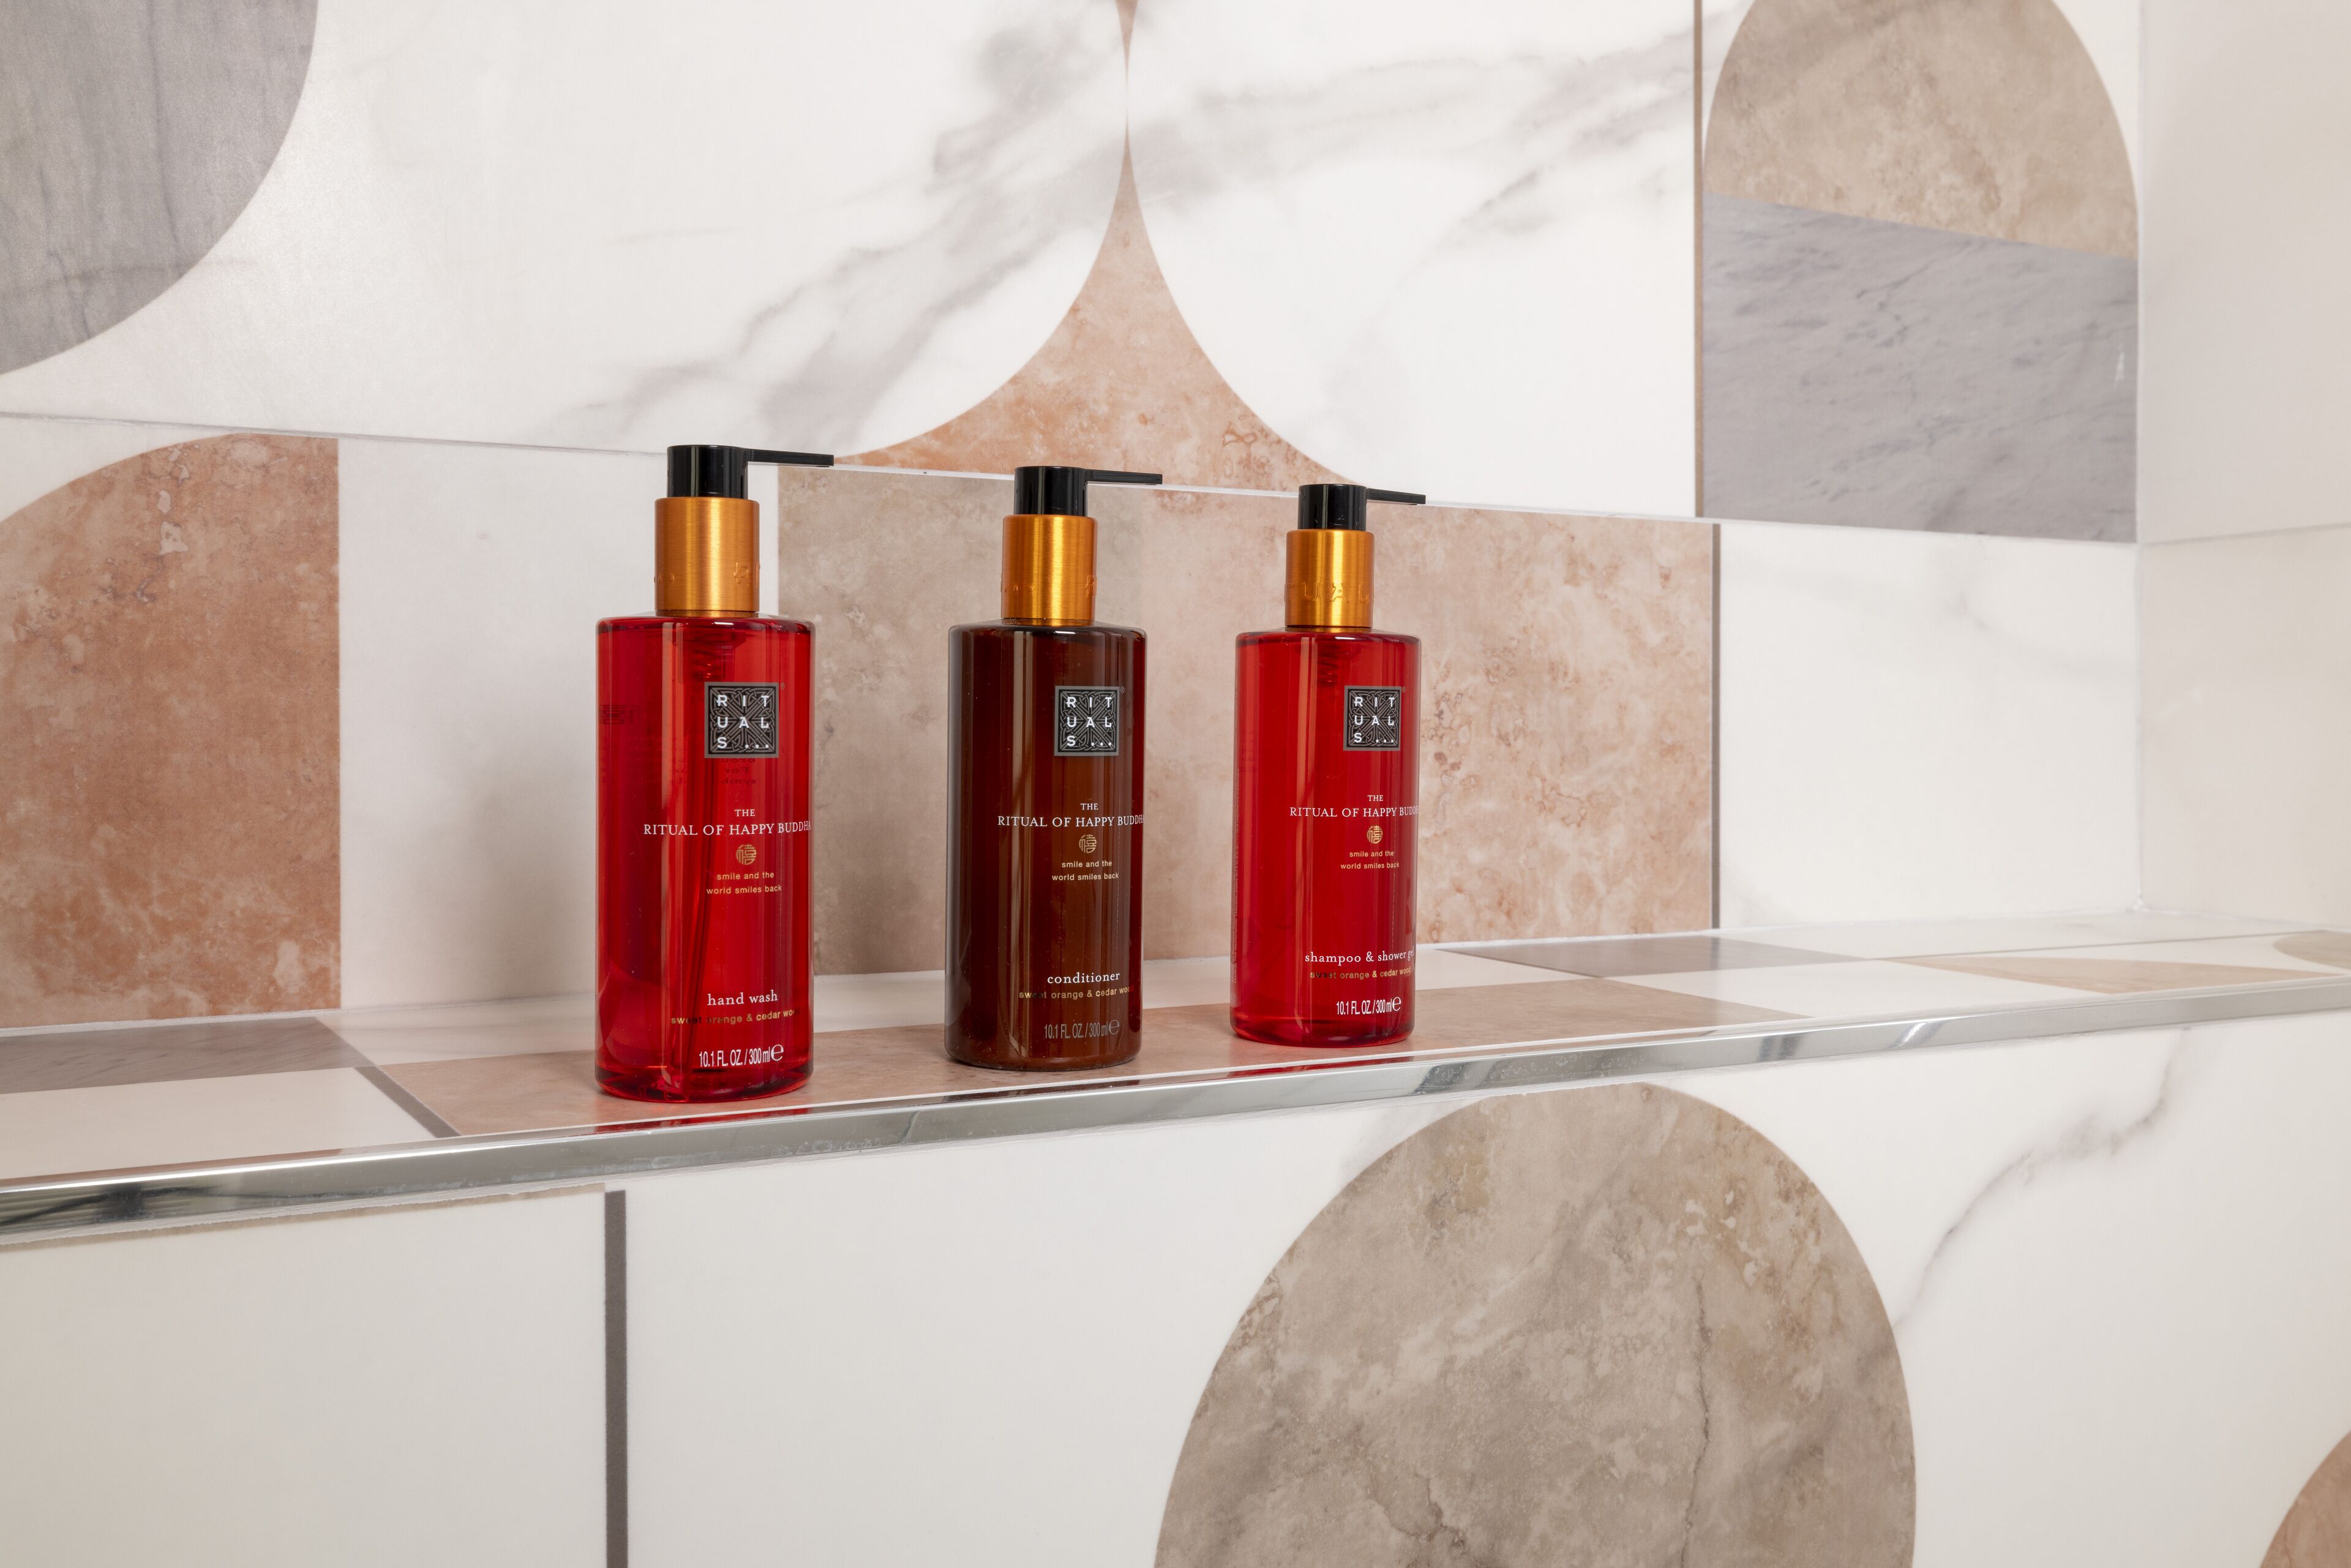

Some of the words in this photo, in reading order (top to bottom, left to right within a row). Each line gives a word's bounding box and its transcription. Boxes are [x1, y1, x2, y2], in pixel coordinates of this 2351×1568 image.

[1289, 807, 1338, 817] RITUAL
[1341, 808, 1359, 817] OF
[1363, 808, 1397, 817] HAPPY
[997, 816, 1048, 827] RITUAL
[1052, 817, 1071, 827] OF
[1075, 816, 1115, 827] HAPPY
[643, 823, 698, 836] RITUAL
[703, 824, 724, 836] OF
[729, 823, 775, 835] HAPPY
[735, 885, 762, 894] smiles
[1305, 951, 1361, 966] shampoo
[1366, 951, 1374, 962] &
[1378, 951, 1406, 961] shower
[1047, 972, 1120, 984] conditioner
[707, 992, 744, 1005] hand
[749, 989, 778, 1003] wash
[1095, 988, 1117, 997] cedar
[1336, 1001, 1349, 1015] 10.1
[1351, 1000, 1360, 1015] FL.
[1361, 1000, 1371, 1015] OZ.
[671, 1016, 702, 1024] sweet
[707, 1016, 743, 1025] orange
[756, 1011, 781, 1021] cedar
[1044, 1024, 1058, 1039] 10.1
[1060, 1024, 1071, 1038] FL.
[1072, 1023, 1084, 1038] OZ.
[699, 1051, 714, 1067] 10.1
[717, 1050, 729, 1067] FL.
[730, 1049, 743, 1066] OZ.
